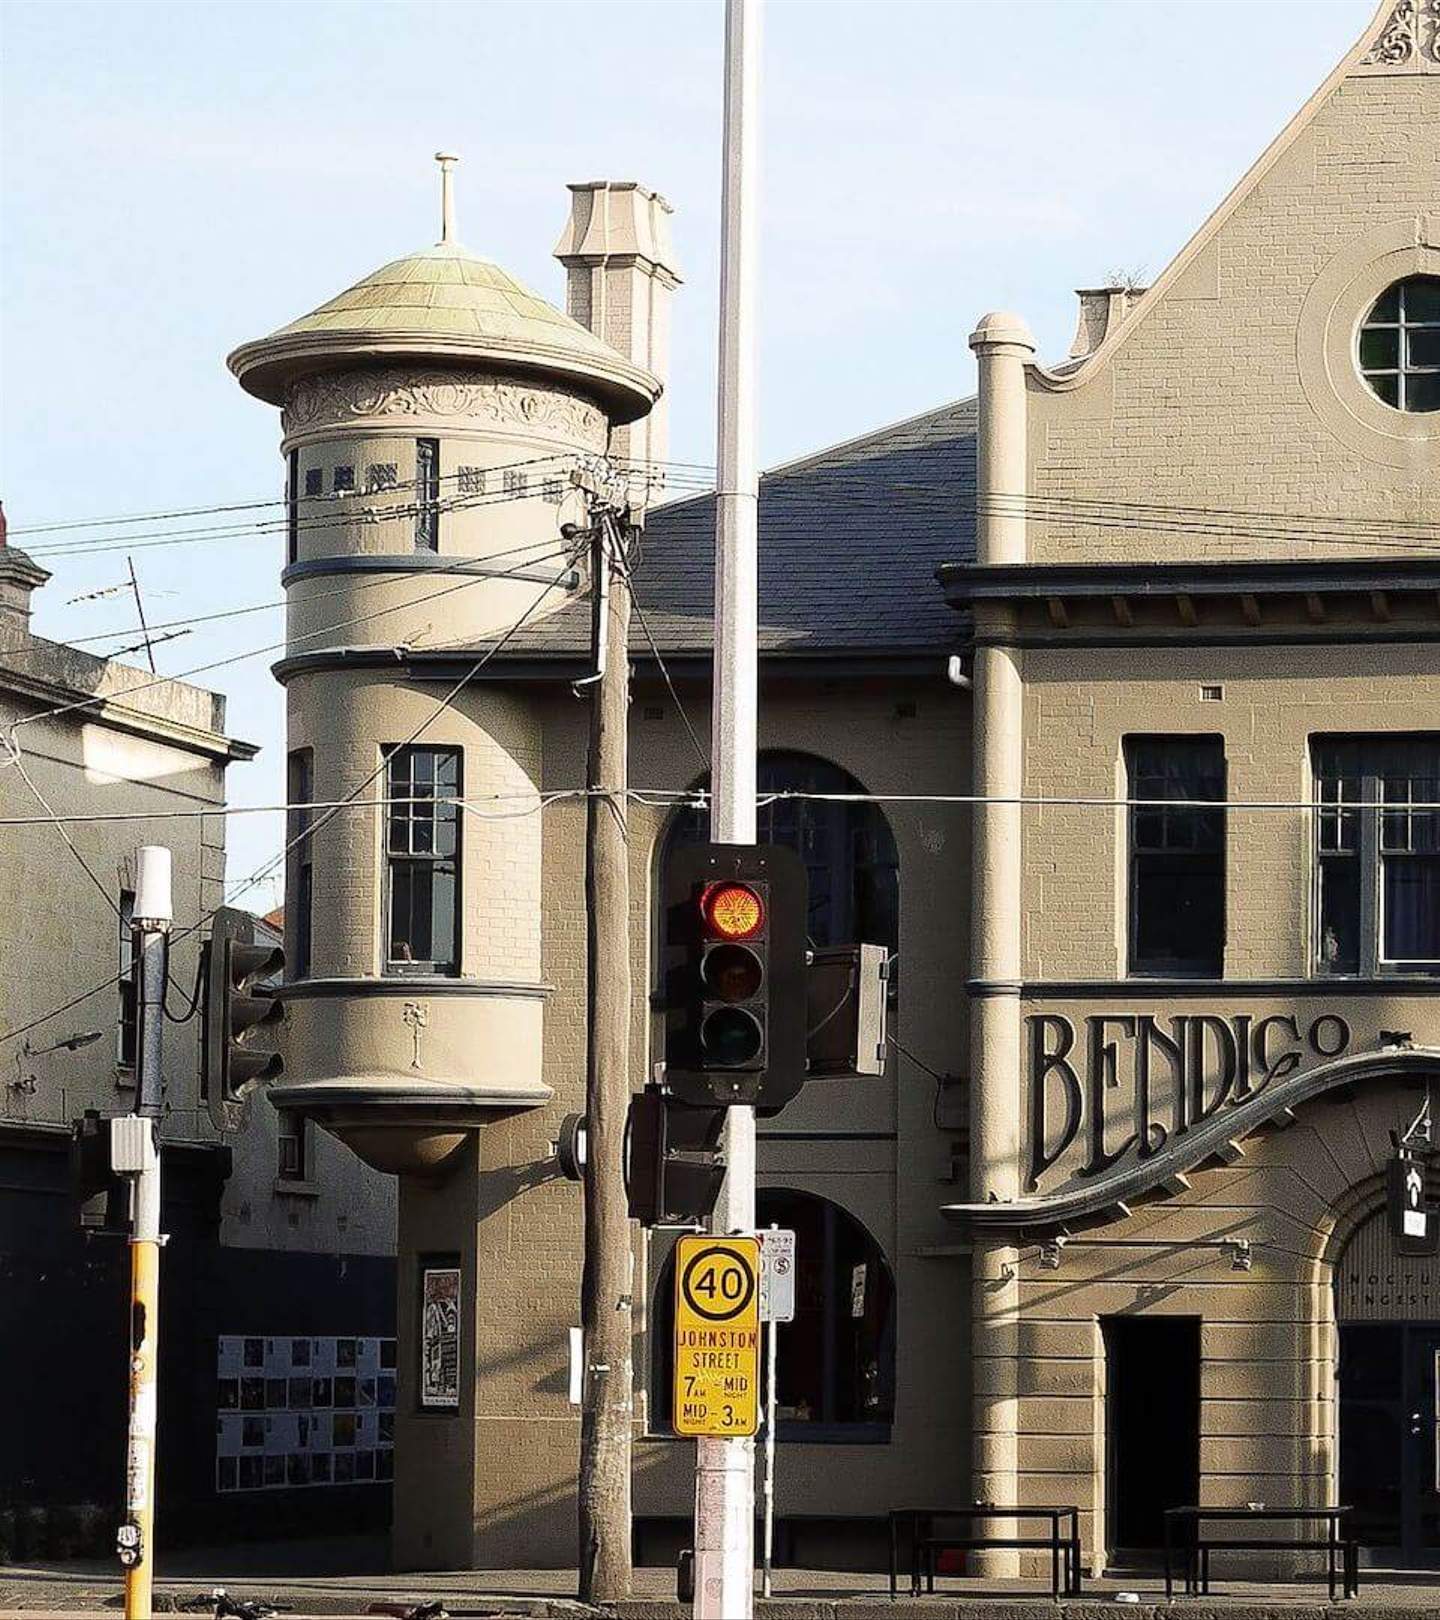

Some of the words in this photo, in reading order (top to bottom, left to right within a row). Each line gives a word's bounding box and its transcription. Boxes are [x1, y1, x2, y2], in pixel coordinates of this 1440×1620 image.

[1024, 1013, 1350, 1192] BENDIGO
[694, 1267, 743, 1300] 40
[679, 1331, 757, 1348] JOHNSTON
[693, 1351, 740, 1369] STREET
[724, 1377, 748, 1391] MID
[684, 1403, 707, 1418] MID
